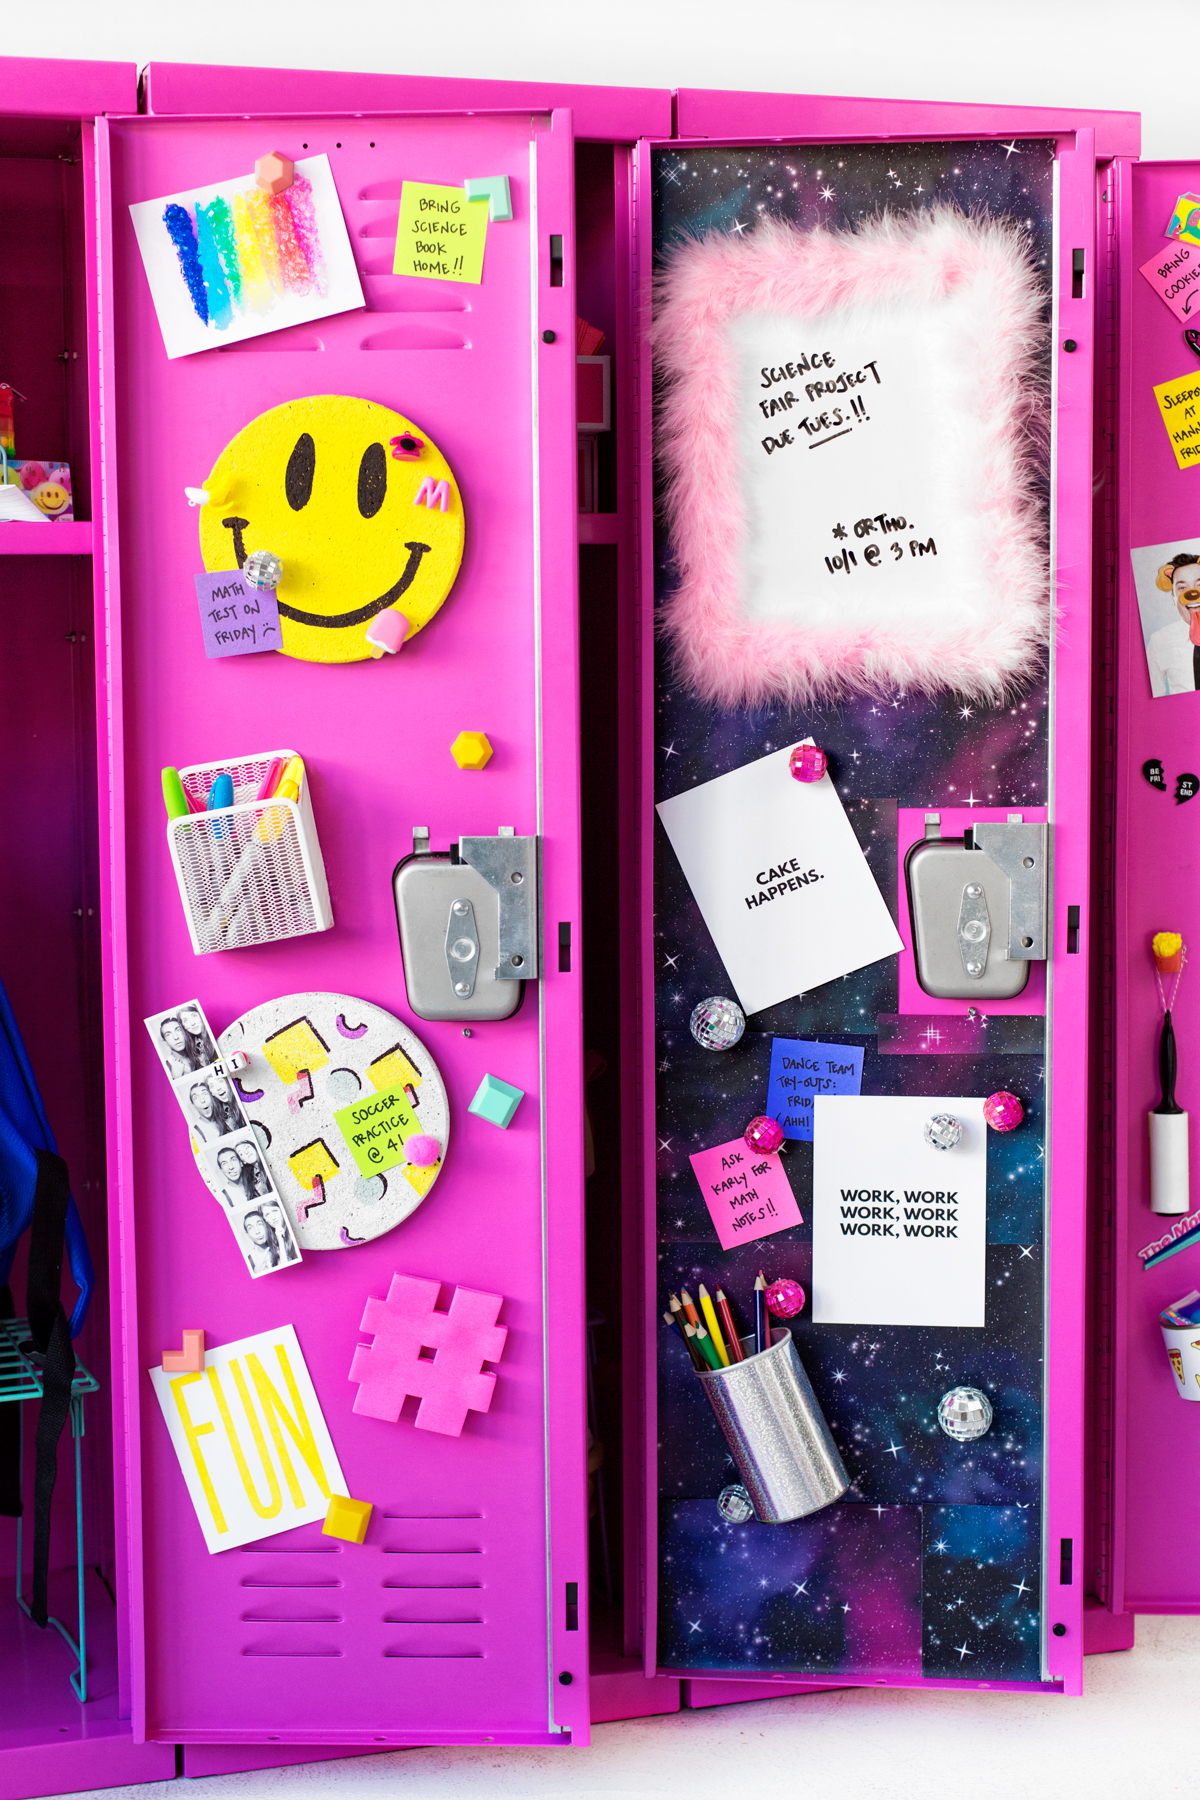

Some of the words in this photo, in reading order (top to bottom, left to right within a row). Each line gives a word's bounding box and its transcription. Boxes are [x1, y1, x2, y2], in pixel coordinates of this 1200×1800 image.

[419, 198, 461, 214] BRING
[411, 220, 468, 236] SCIENCE
[415, 240, 447, 256] BOOK
[413, 255, 464, 276] HOME!!
[1157, 248, 1190, 279] BRING
[1164, 263, 1200, 300] COOKIE
[760, 351, 836, 389] SCIENCE
[758, 391, 800, 419] FAIR
[805, 360, 881, 402] PROJECT
[1163, 386, 1200, 410] SLEEPO
[1184, 404, 1196, 420] AT
[760, 428, 795, 456] DUE
[413, 476, 450, 513] M
[853, 513, 915, 539] ORTHO.
[824, 548, 858, 575] 10/1
[863, 543, 882, 567] @
[890, 541, 904, 561] 3
[908, 537, 938, 557] PM
[211, 581, 246, 602] MATH
[207, 604, 238, 623] TEST
[243, 599, 261, 615] ON
[214, 624, 257, 645] FRIDAY
[1149, 767, 1160, 776] BE
[1149, 775, 1161, 783] FRI
[1179, 788, 1194, 797] END
[1181, 781, 1193, 789] ST
[755, 857, 801, 886] CAKE
[744, 868, 825, 910] HAPPENS.
[213, 1058, 239, 1077] HI
[781, 1057, 820, 1072] DANCE
[825, 1061, 855, 1076] TEAM
[775, 1075, 837, 1092] TRY-OUTS:
[351, 1094, 400, 1125] SOCCER
[787, 1095, 814, 1110] FRID
[351, 1113, 410, 1148] PRACTICE
[367, 1146, 384, 1164] @
[721, 1152, 744, 1171] ASK
[710, 1172, 748, 1196] KARLY
[751, 1161, 772, 1177] FOR
[729, 1188, 759, 1210] MATH
[840, 1189, 900, 1205] WORK,
[903, 1190, 959, 1204] WORK
[731, 1197, 778, 1232] NOTES!!
[840, 1206, 900, 1222] WORK,
[903, 1207, 959, 1221] WORK
[840, 1223, 900, 1239] WORK,
[903, 1224, 959, 1238] WORK
[1140, 1236, 1171, 1259] The
[1172, 1212, 1200, 1239] Mo
[169, 1344, 333, 1534] FUN
